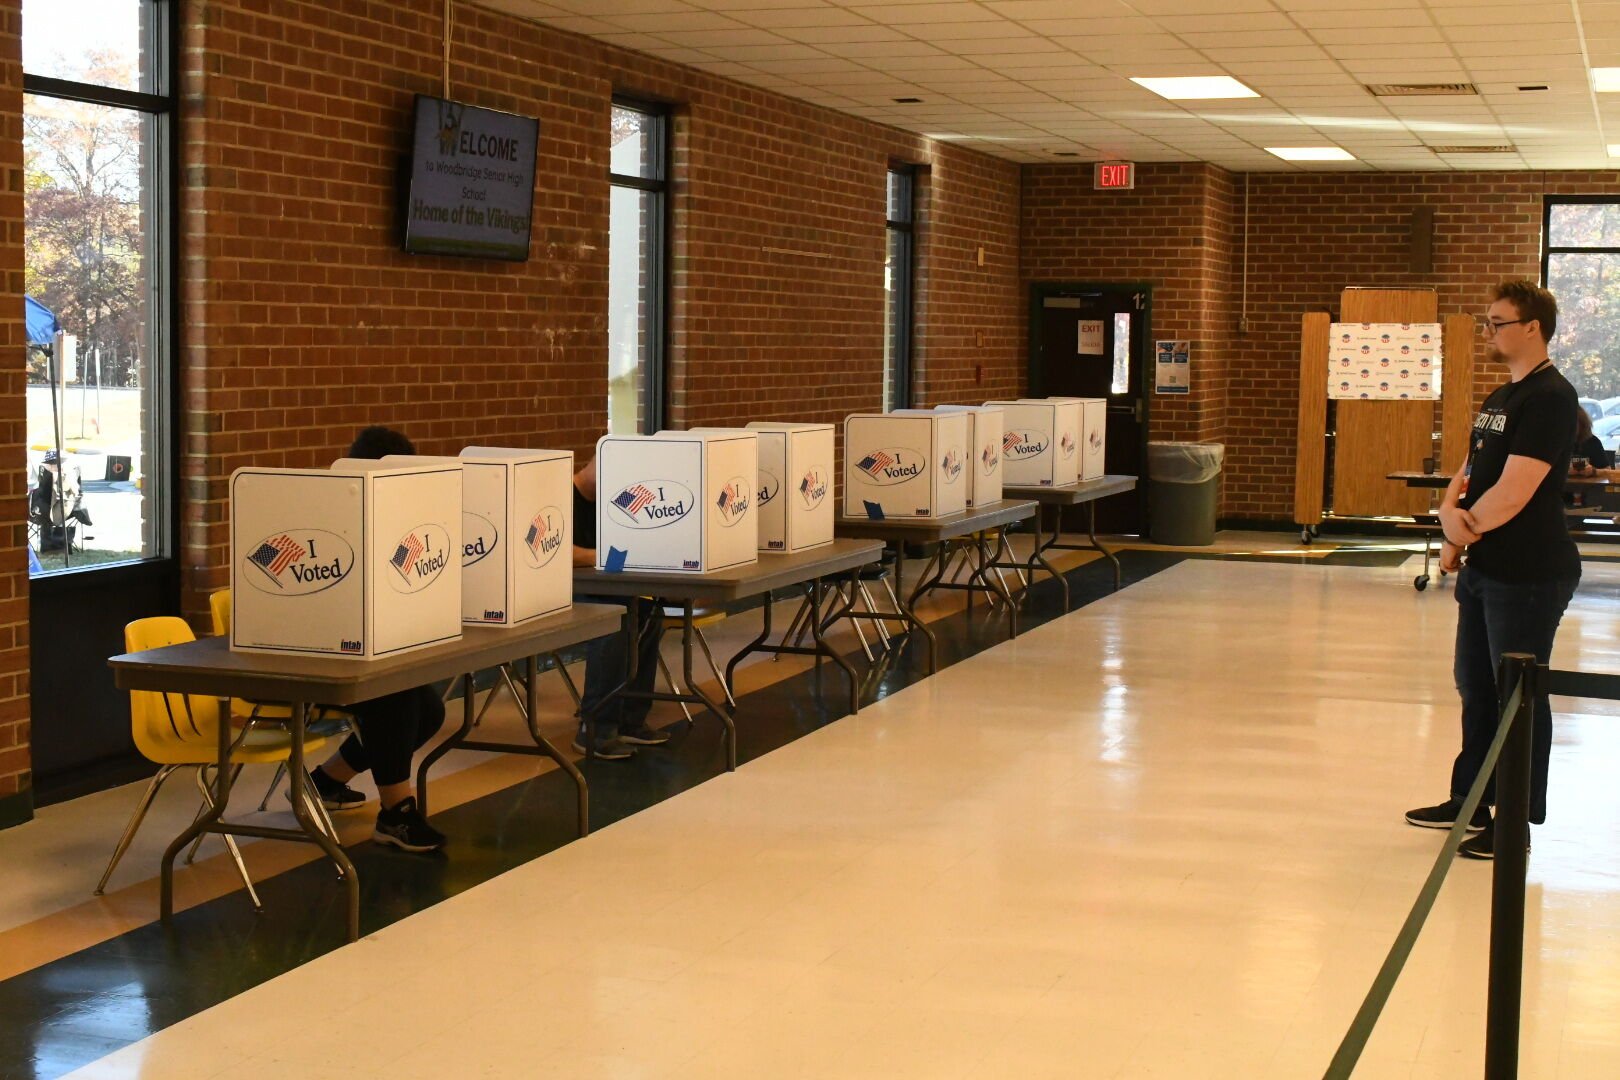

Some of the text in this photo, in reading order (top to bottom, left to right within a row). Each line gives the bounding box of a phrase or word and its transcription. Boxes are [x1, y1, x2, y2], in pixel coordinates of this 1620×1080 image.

[425, 161, 524, 188] to Woodbridge Senior High
[1101, 165, 1129, 186] EXIT
[462, 186, 487, 201] School
[413, 198, 449, 222] Home
[451, 204, 465, 225] of
[466, 206, 484, 226] the
[1081, 324, 1101, 333] EXIT
[1013, 442, 1042, 455] Voted
[1023, 433, 1029, 444] I
[895, 453, 902, 465] I
[883, 463, 918, 479] Voted
[657, 486, 665, 502] I
[643, 500, 685, 520] Voted
[730, 495, 748, 517] Voted
[307, 539, 318, 559] I
[425, 533, 431, 553] I
[541, 528, 560, 555] Voted
[289, 557, 342, 583] Voted
[414, 549, 443, 578] Voted
[484, 609, 504, 619] intab
[340, 639, 362, 651] intab
